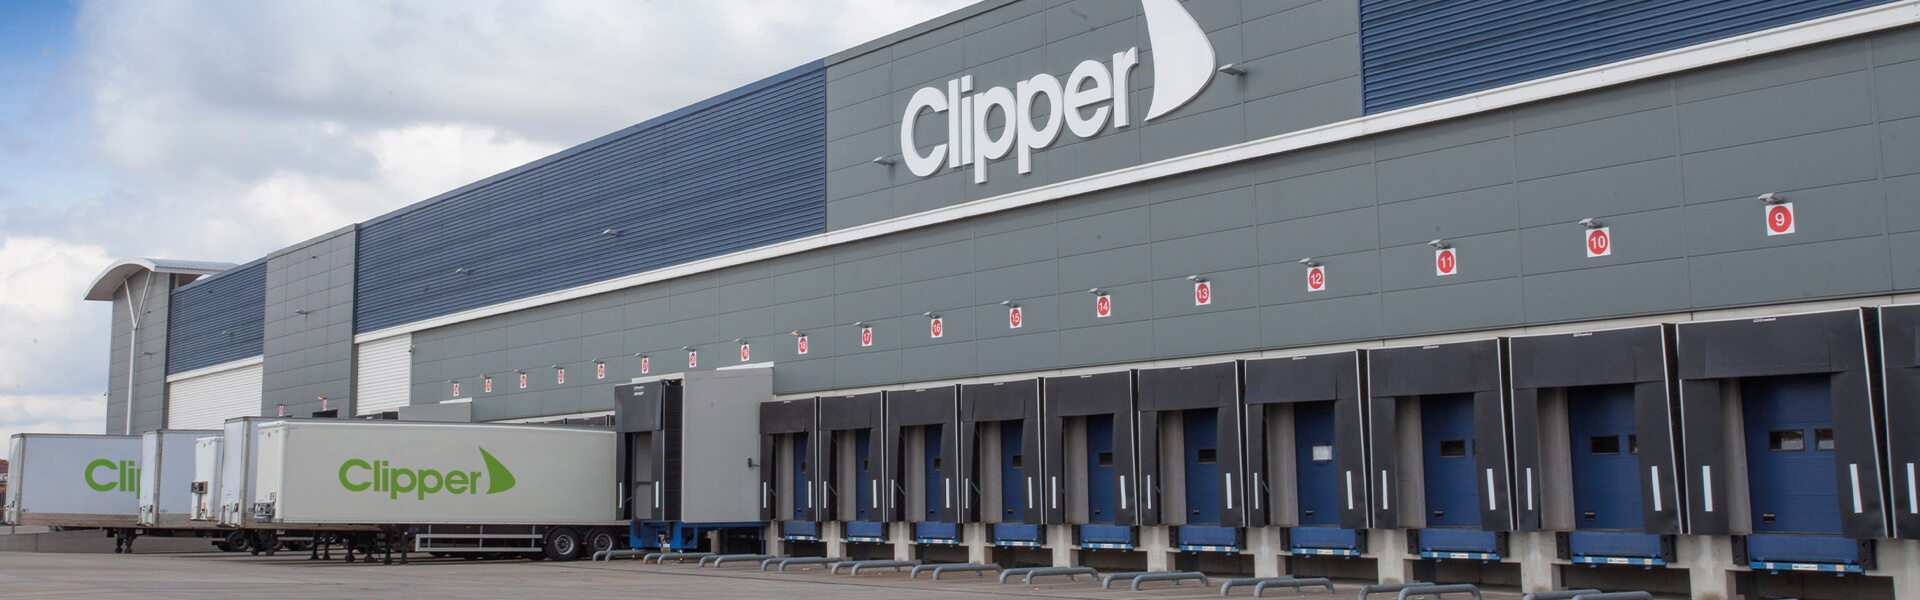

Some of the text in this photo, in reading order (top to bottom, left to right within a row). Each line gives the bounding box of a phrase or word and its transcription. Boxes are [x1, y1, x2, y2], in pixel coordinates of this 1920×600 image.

[901, 46, 1138, 184] Clipper
[1590, 235, 1606, 250] 10
[1440, 255, 1453, 269] 11
[1310, 272, 1322, 285] 12
[85, 459, 141, 499] Cli
[338, 458, 482, 500] Clipper
